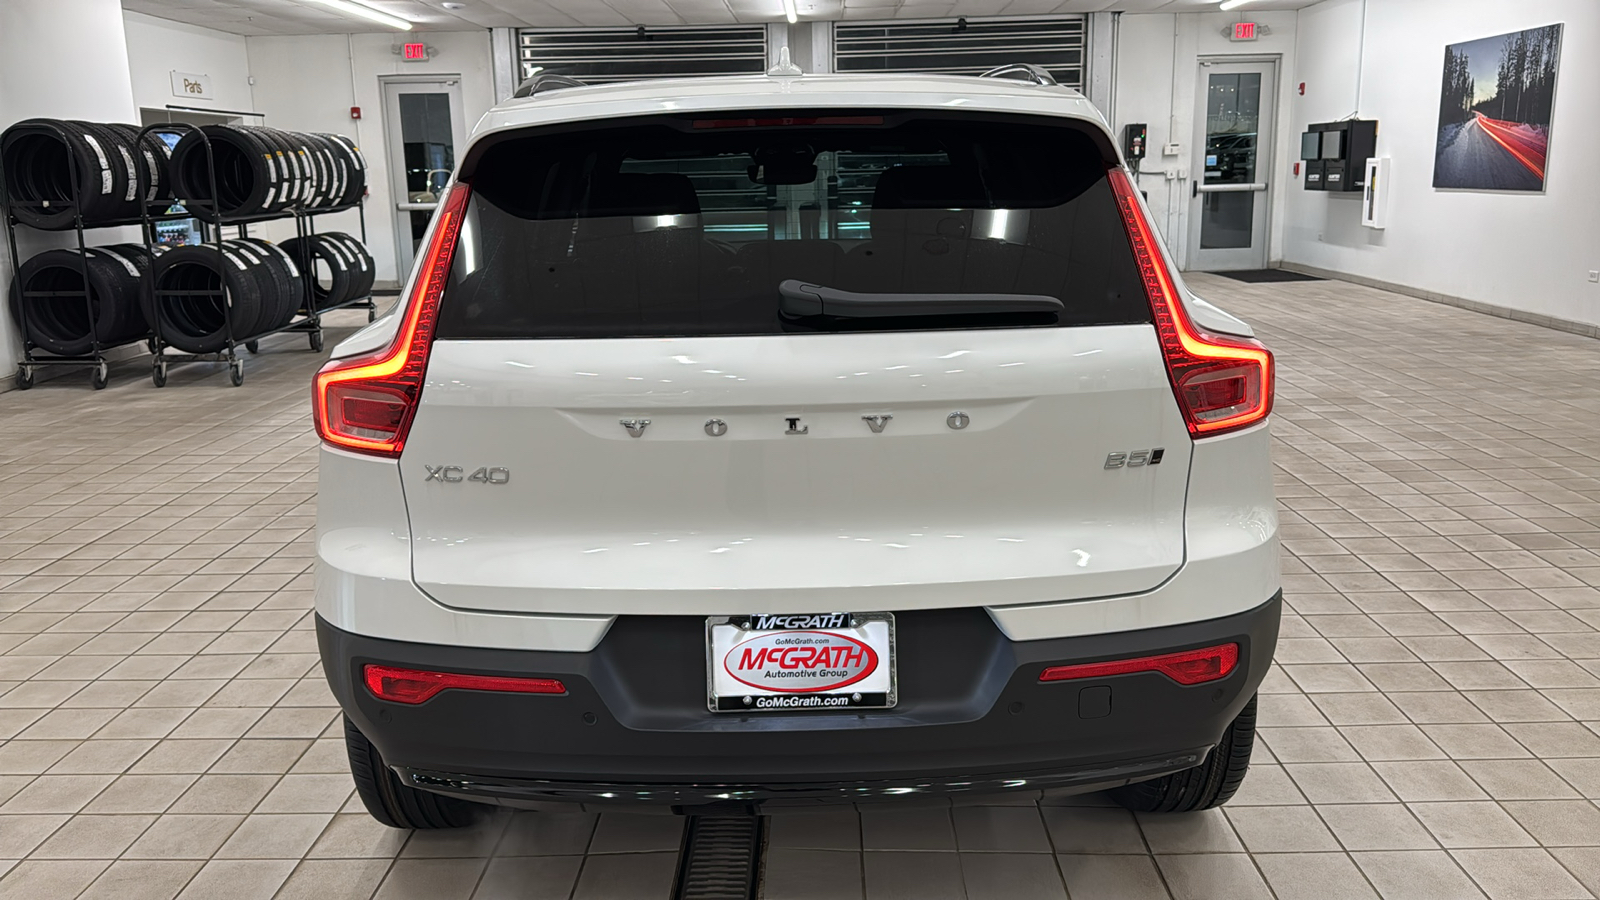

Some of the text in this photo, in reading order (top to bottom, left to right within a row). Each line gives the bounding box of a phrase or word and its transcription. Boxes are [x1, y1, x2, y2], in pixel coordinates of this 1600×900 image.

[1235, 22, 1255, 39] EXIT
[404, 43, 424, 59] EXIT
[183, 78, 203, 94] Parts
[619, 410, 970, 438] VOLVO
[1104, 449, 1150, 470] B5
[775, 637, 829, 646] GoMcGrath.com
[764, 668, 848, 679] Automotive Group
[756, 696, 849, 708] GoMcGrath.com
